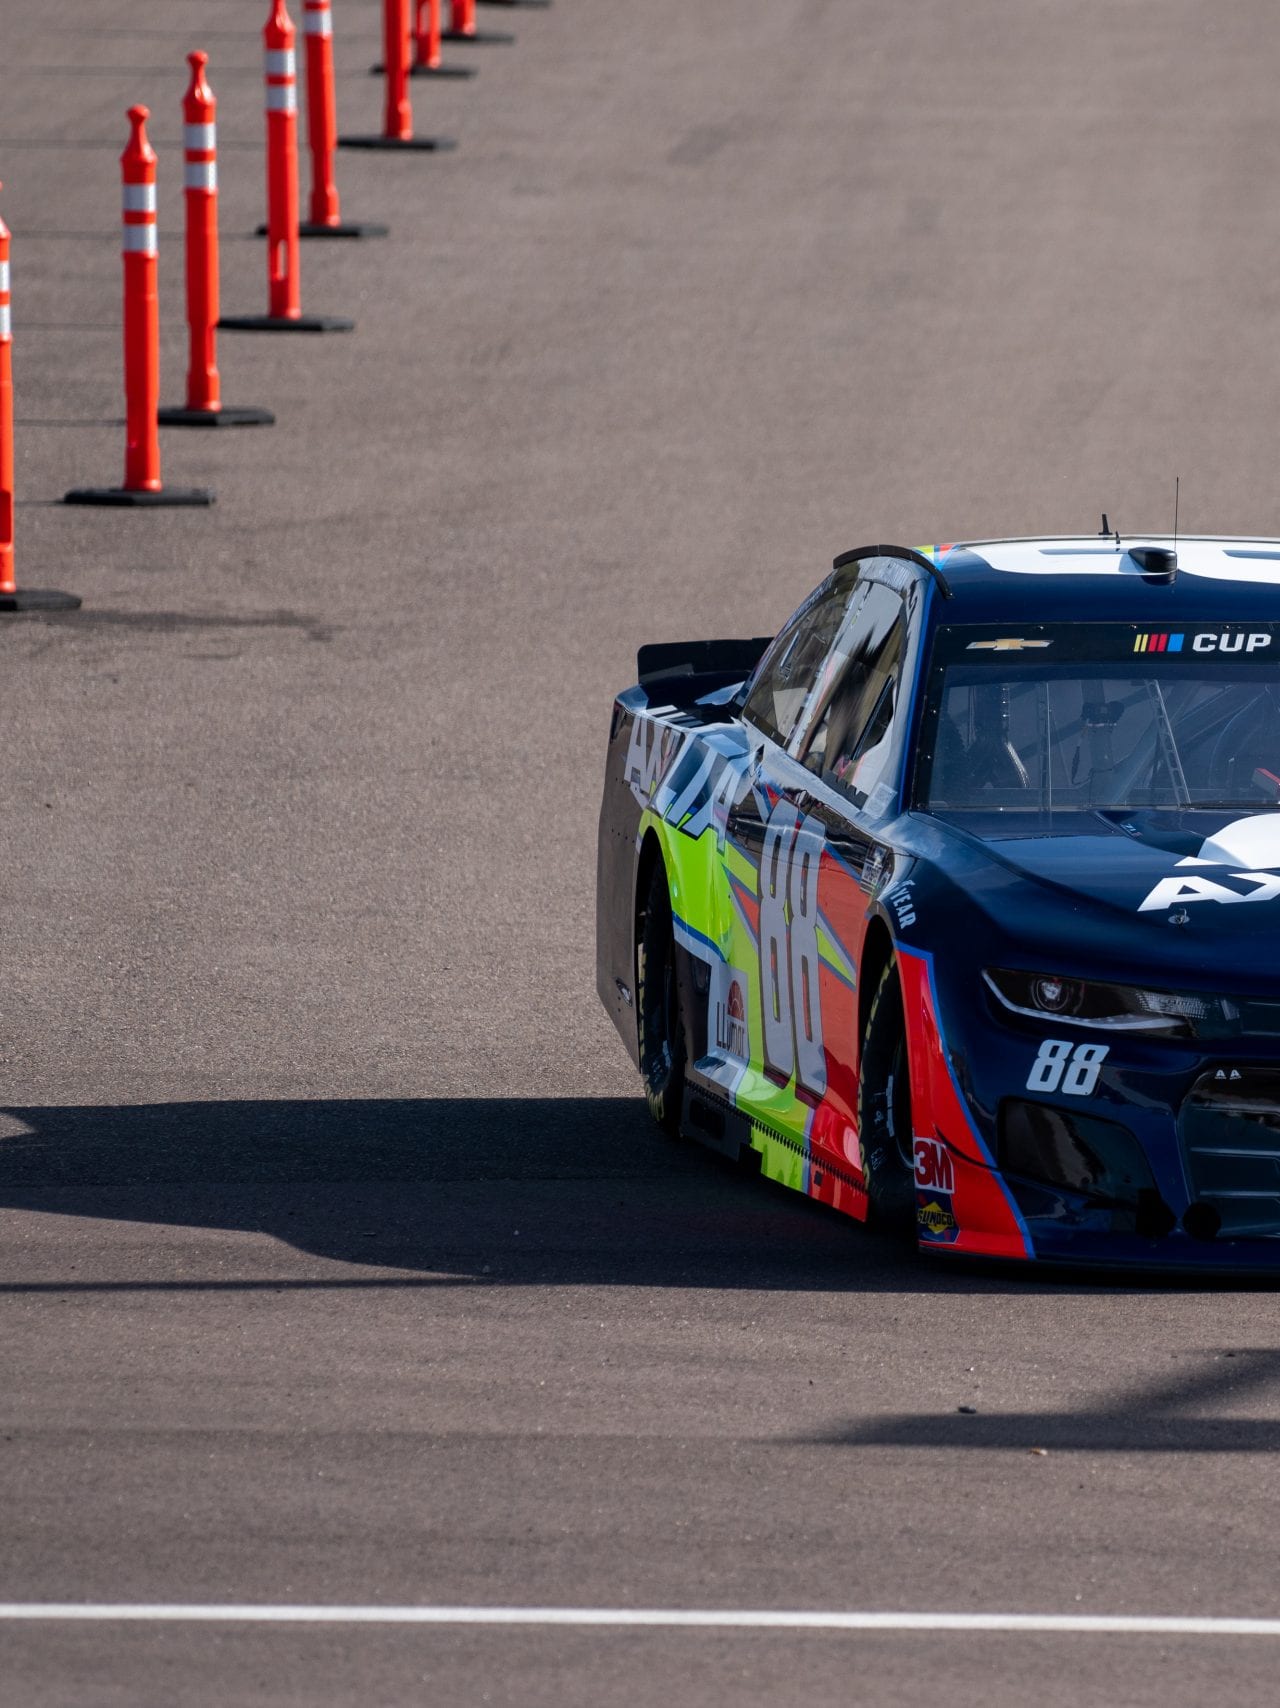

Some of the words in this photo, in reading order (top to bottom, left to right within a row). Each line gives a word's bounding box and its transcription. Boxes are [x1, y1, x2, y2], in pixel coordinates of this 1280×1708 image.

[1192, 633, 1271, 653] CUP
[759, 799, 827, 1094] 88
[1026, 1039, 1110, 1096] 88
[914, 1140, 953, 1190] 3M
[917, 1210, 953, 1226] SUNOCO
